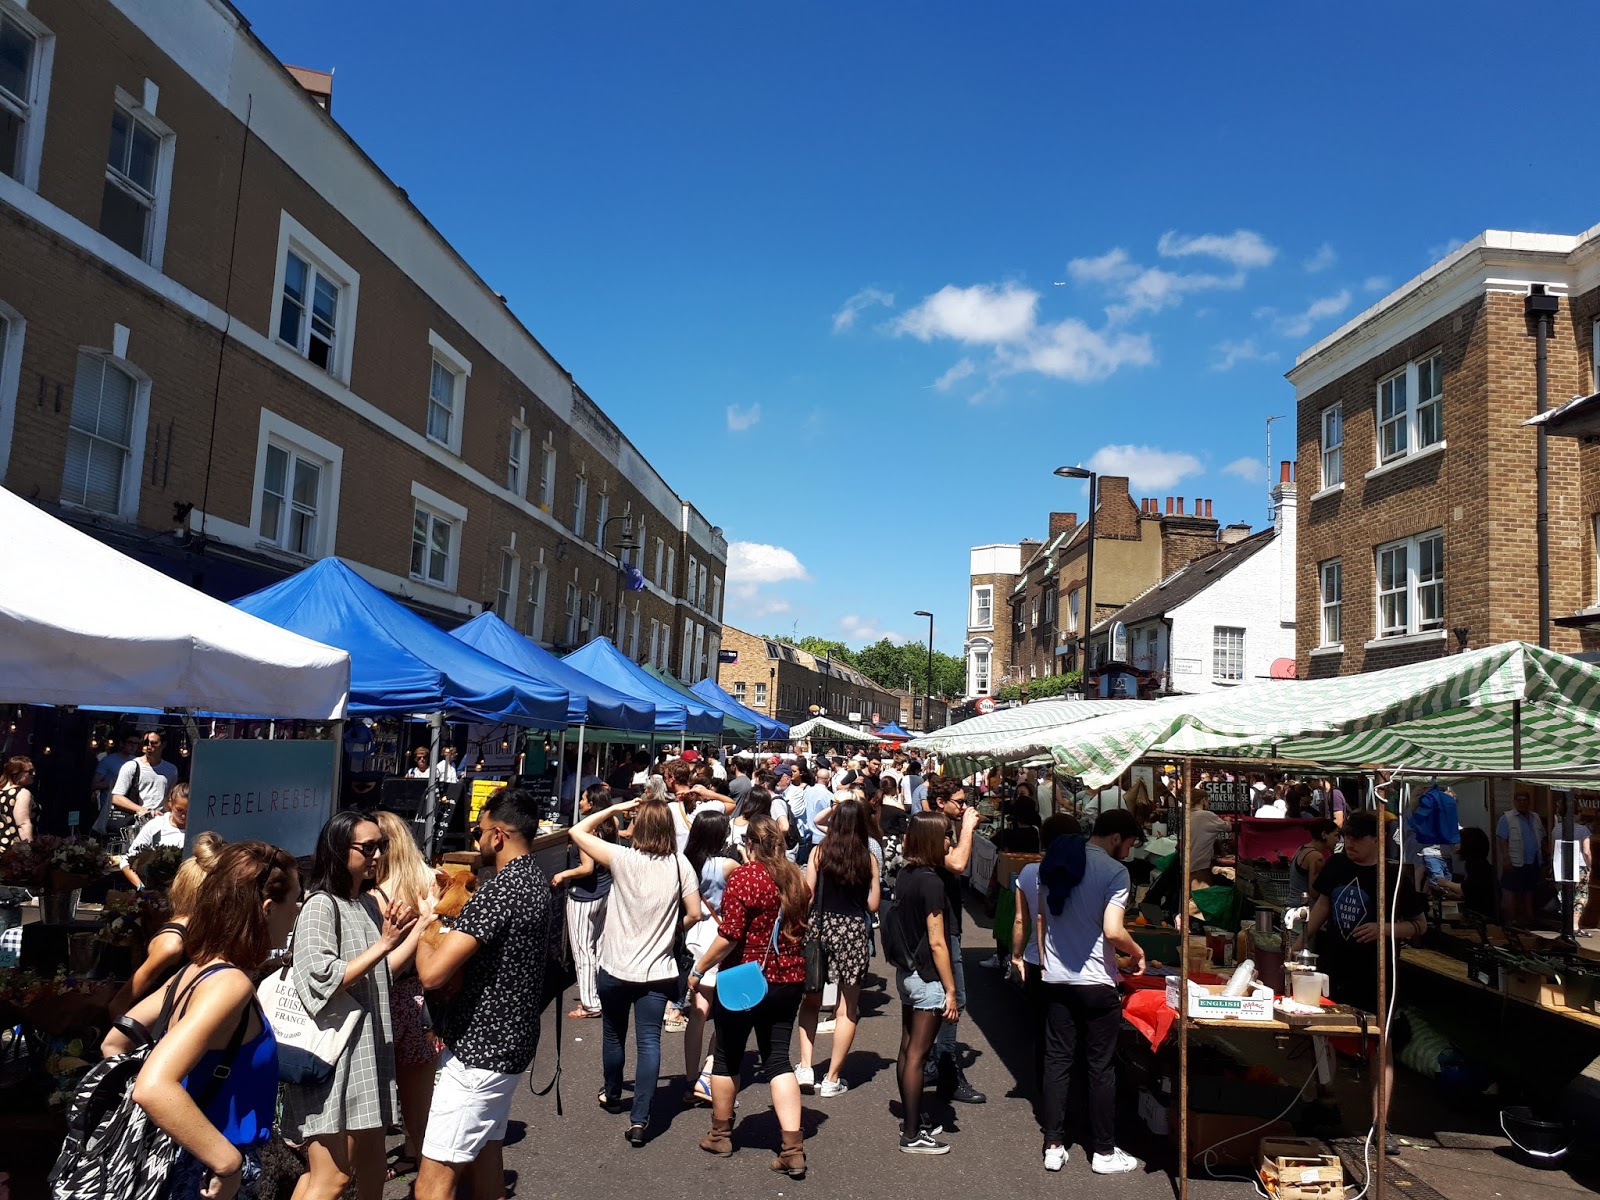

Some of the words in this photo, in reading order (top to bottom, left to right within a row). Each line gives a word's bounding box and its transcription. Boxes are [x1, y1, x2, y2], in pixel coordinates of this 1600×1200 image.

[207, 791, 263, 818] REBEL
[270, 787, 318, 812] REBEL
[1345, 896, 1357, 904] LIN
[275, 983, 287, 996] LE
[1199, 1000, 1240, 1008] ENGLISH
[274, 1011, 307, 1026] FRANCE
